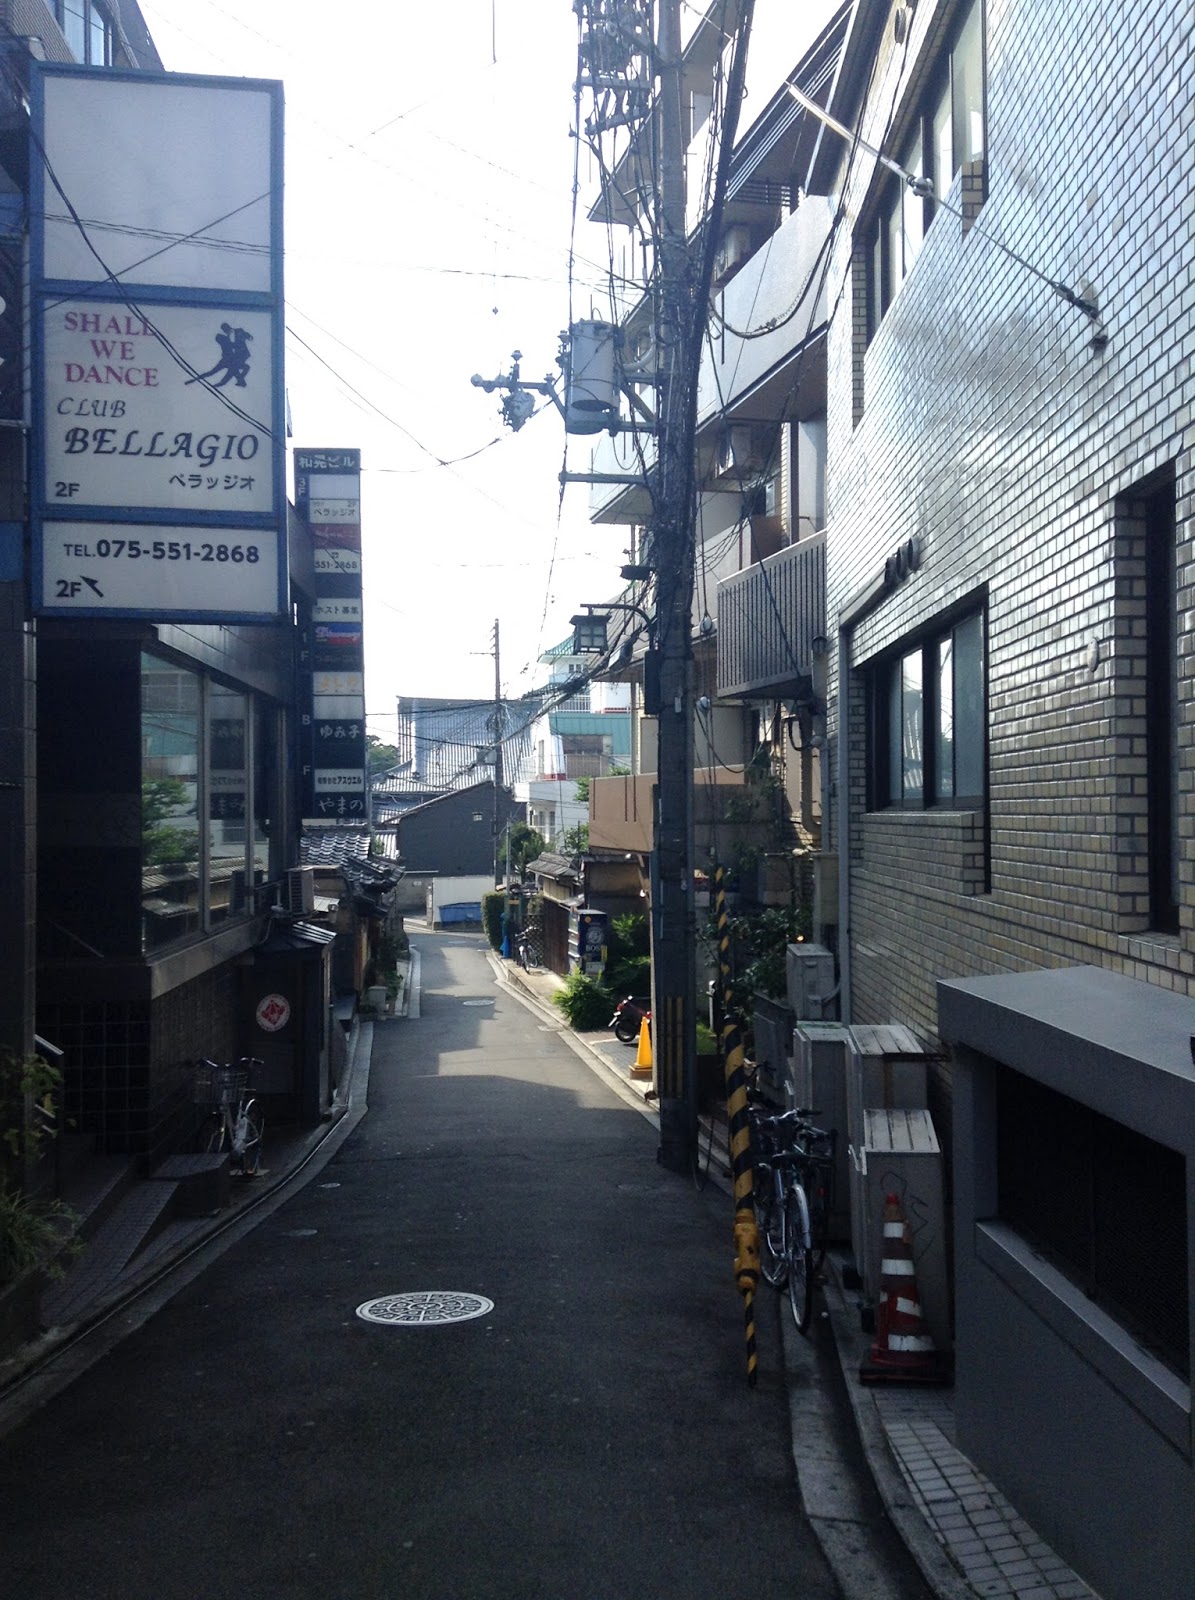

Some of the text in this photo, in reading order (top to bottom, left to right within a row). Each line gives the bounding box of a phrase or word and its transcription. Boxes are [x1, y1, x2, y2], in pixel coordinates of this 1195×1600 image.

[64, 311, 157, 337] SHALL
[90, 339, 136, 360] WE
[64, 363, 160, 387] DANCE
[57, 397, 127, 418] CLUB
[64, 427, 259, 467] BELLAGIO
[55, 481, 80, 497] 2F
[169, 474, 256, 491] ベラッジオ
[56, 580, 82, 598] 2F
[318, 796, 363, 814] やまの
[586, 944, 601, 952] BOS
